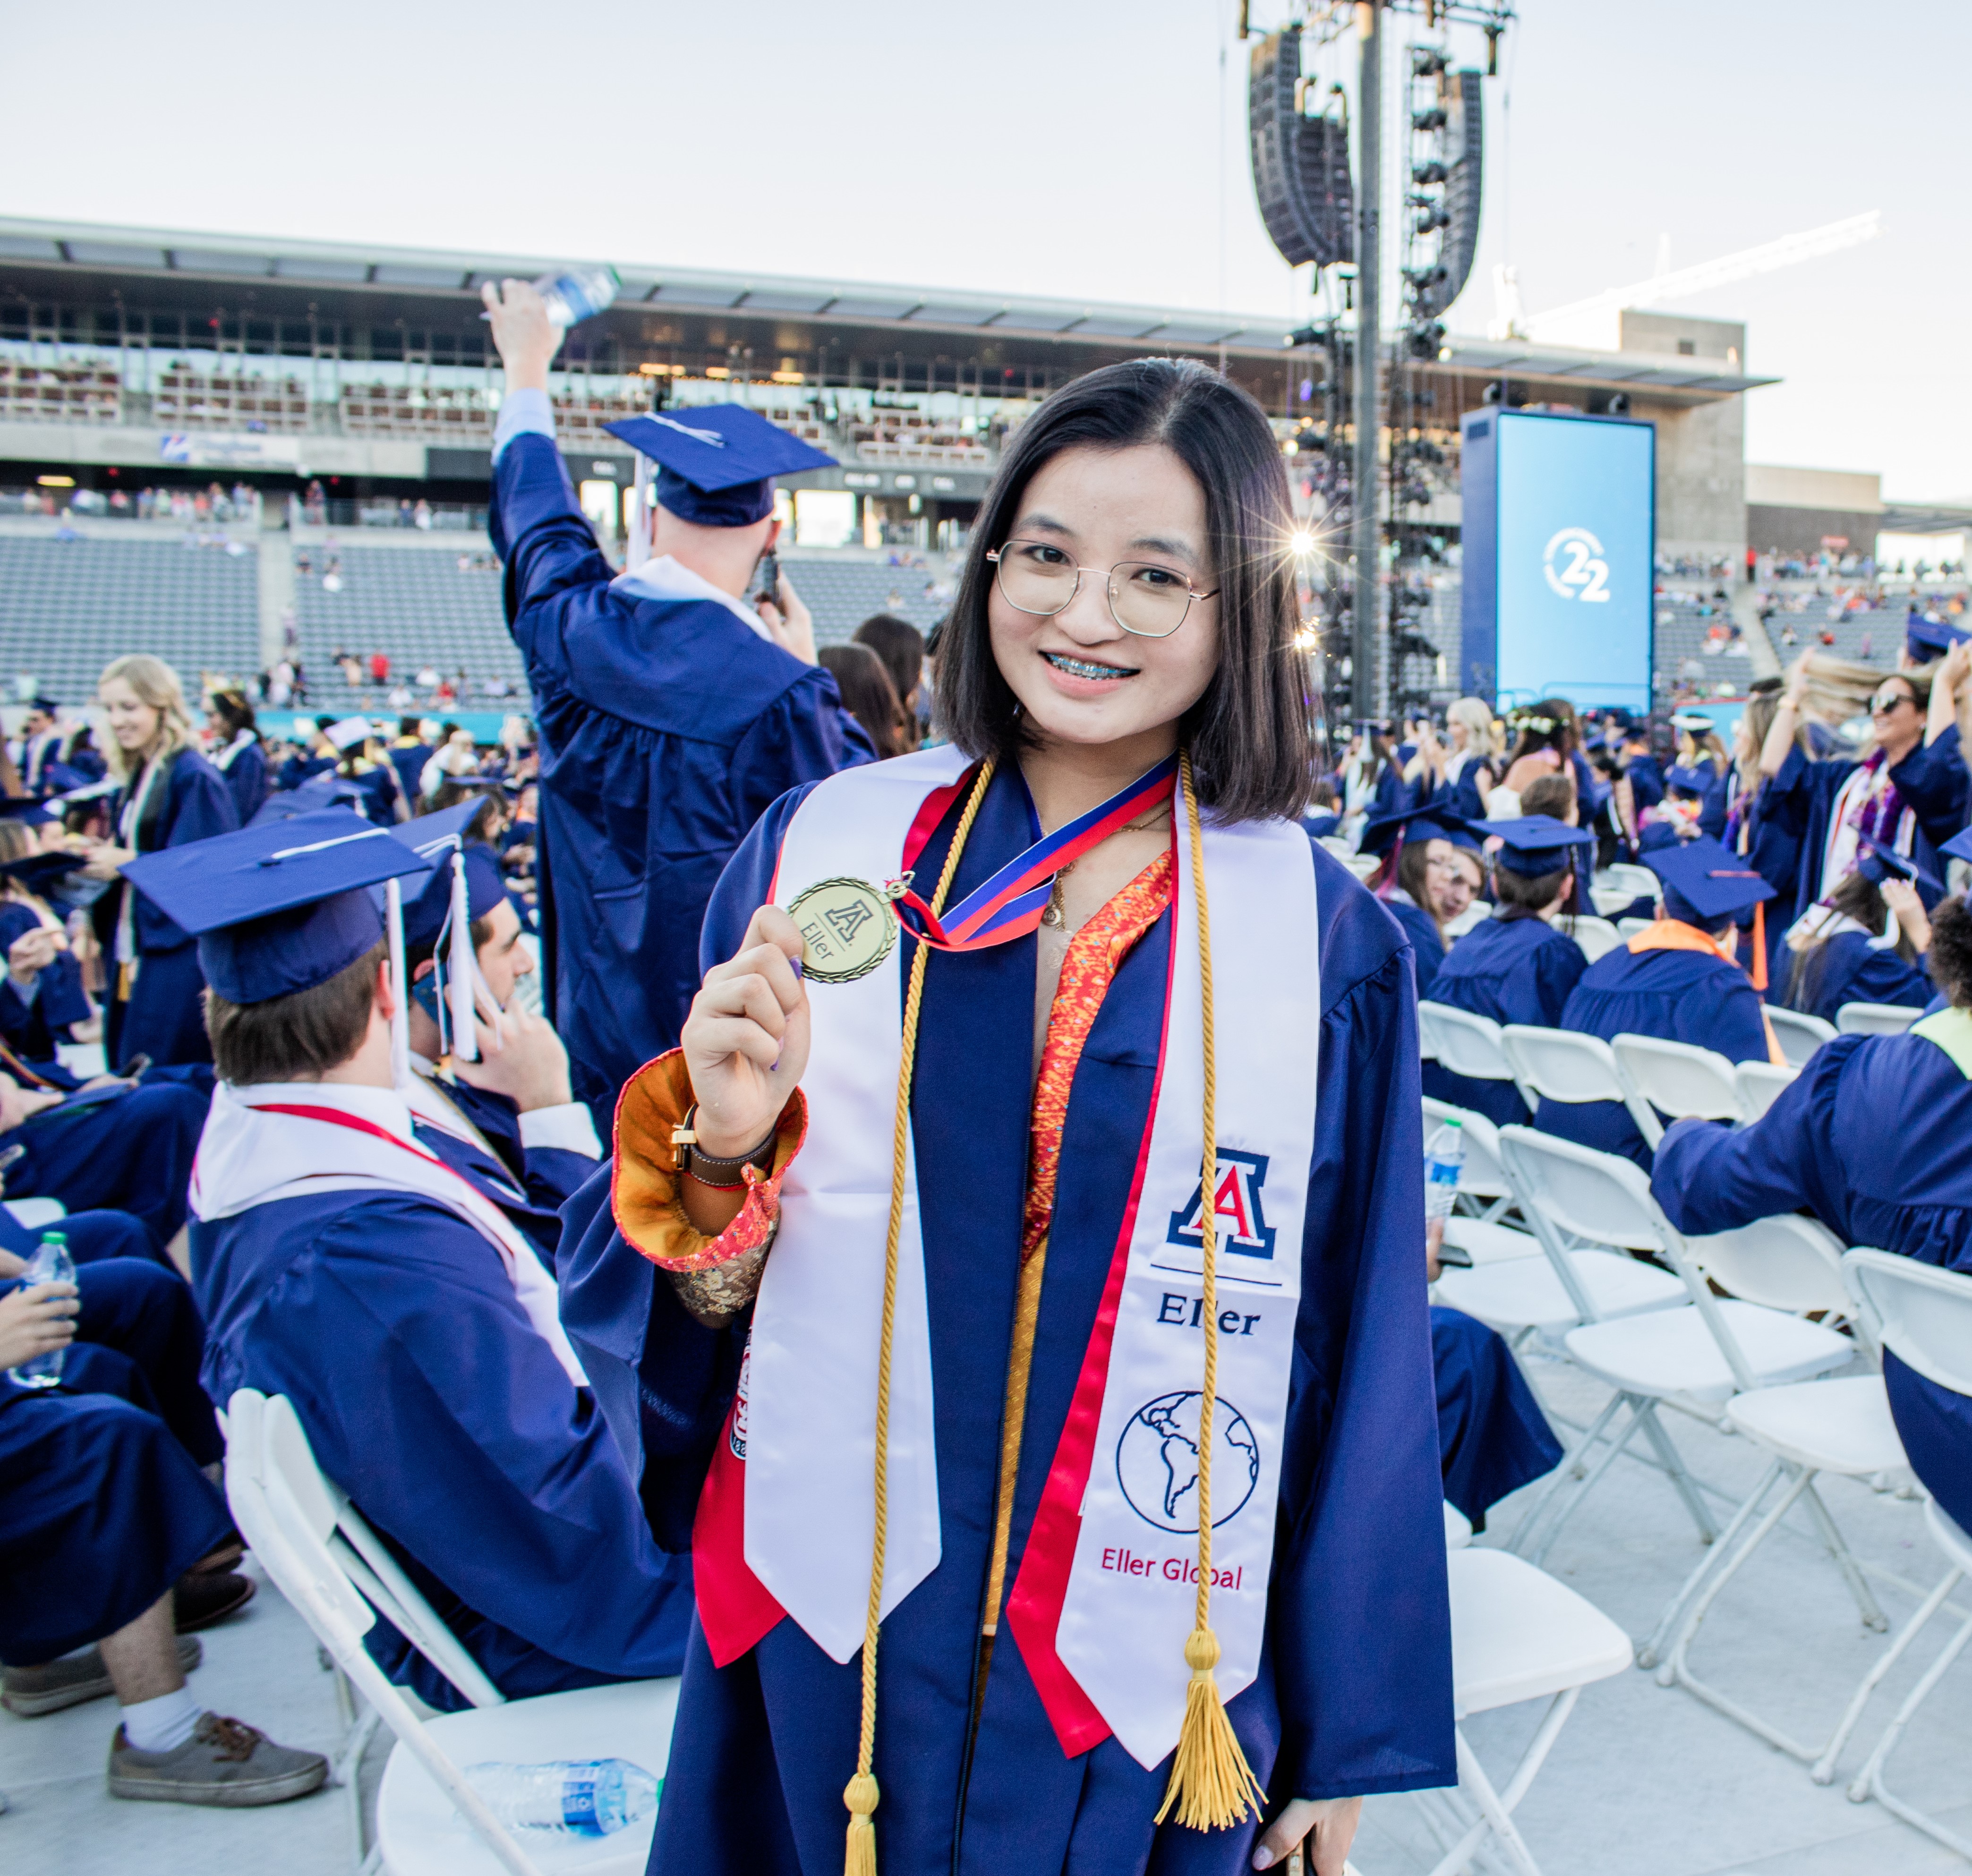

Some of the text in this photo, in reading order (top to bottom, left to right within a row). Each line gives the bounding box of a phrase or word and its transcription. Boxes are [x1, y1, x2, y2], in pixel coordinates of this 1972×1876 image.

[1560, 540, 1611, 602] 22
[800, 922, 835, 960] Eller
[825, 899, 874, 943] A
[1166, 1147, 1277, 1260] A
[1156, 1292, 1261, 1336] Eler
[733, 1437, 746, 1455] 188
[1101, 1548, 1156, 1577] Eller
